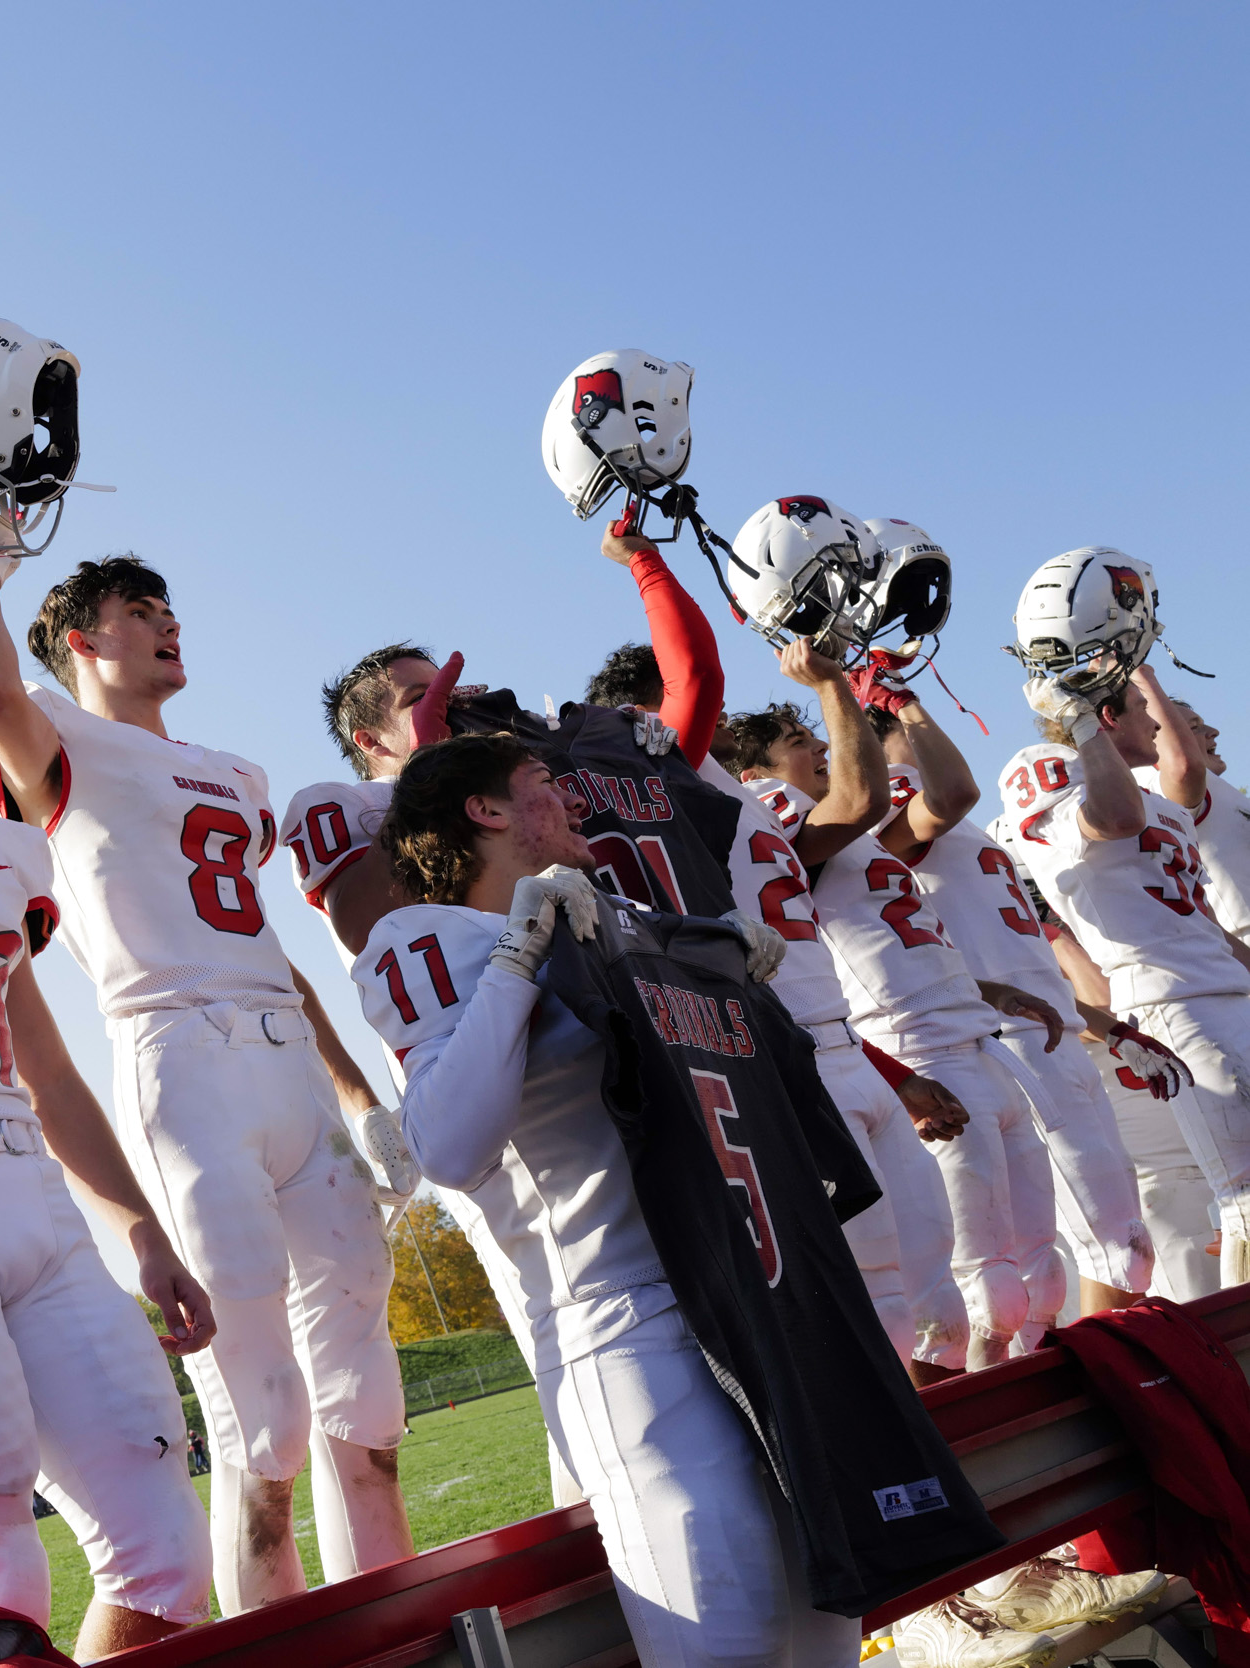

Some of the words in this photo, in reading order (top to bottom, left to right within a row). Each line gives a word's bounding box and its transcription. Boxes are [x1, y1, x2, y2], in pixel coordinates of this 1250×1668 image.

[172, 775, 241, 802] CARDINALS
[1005, 756, 1070, 808] 30
[180, 803, 265, 937] 8
[374, 933, 460, 1025] 11
